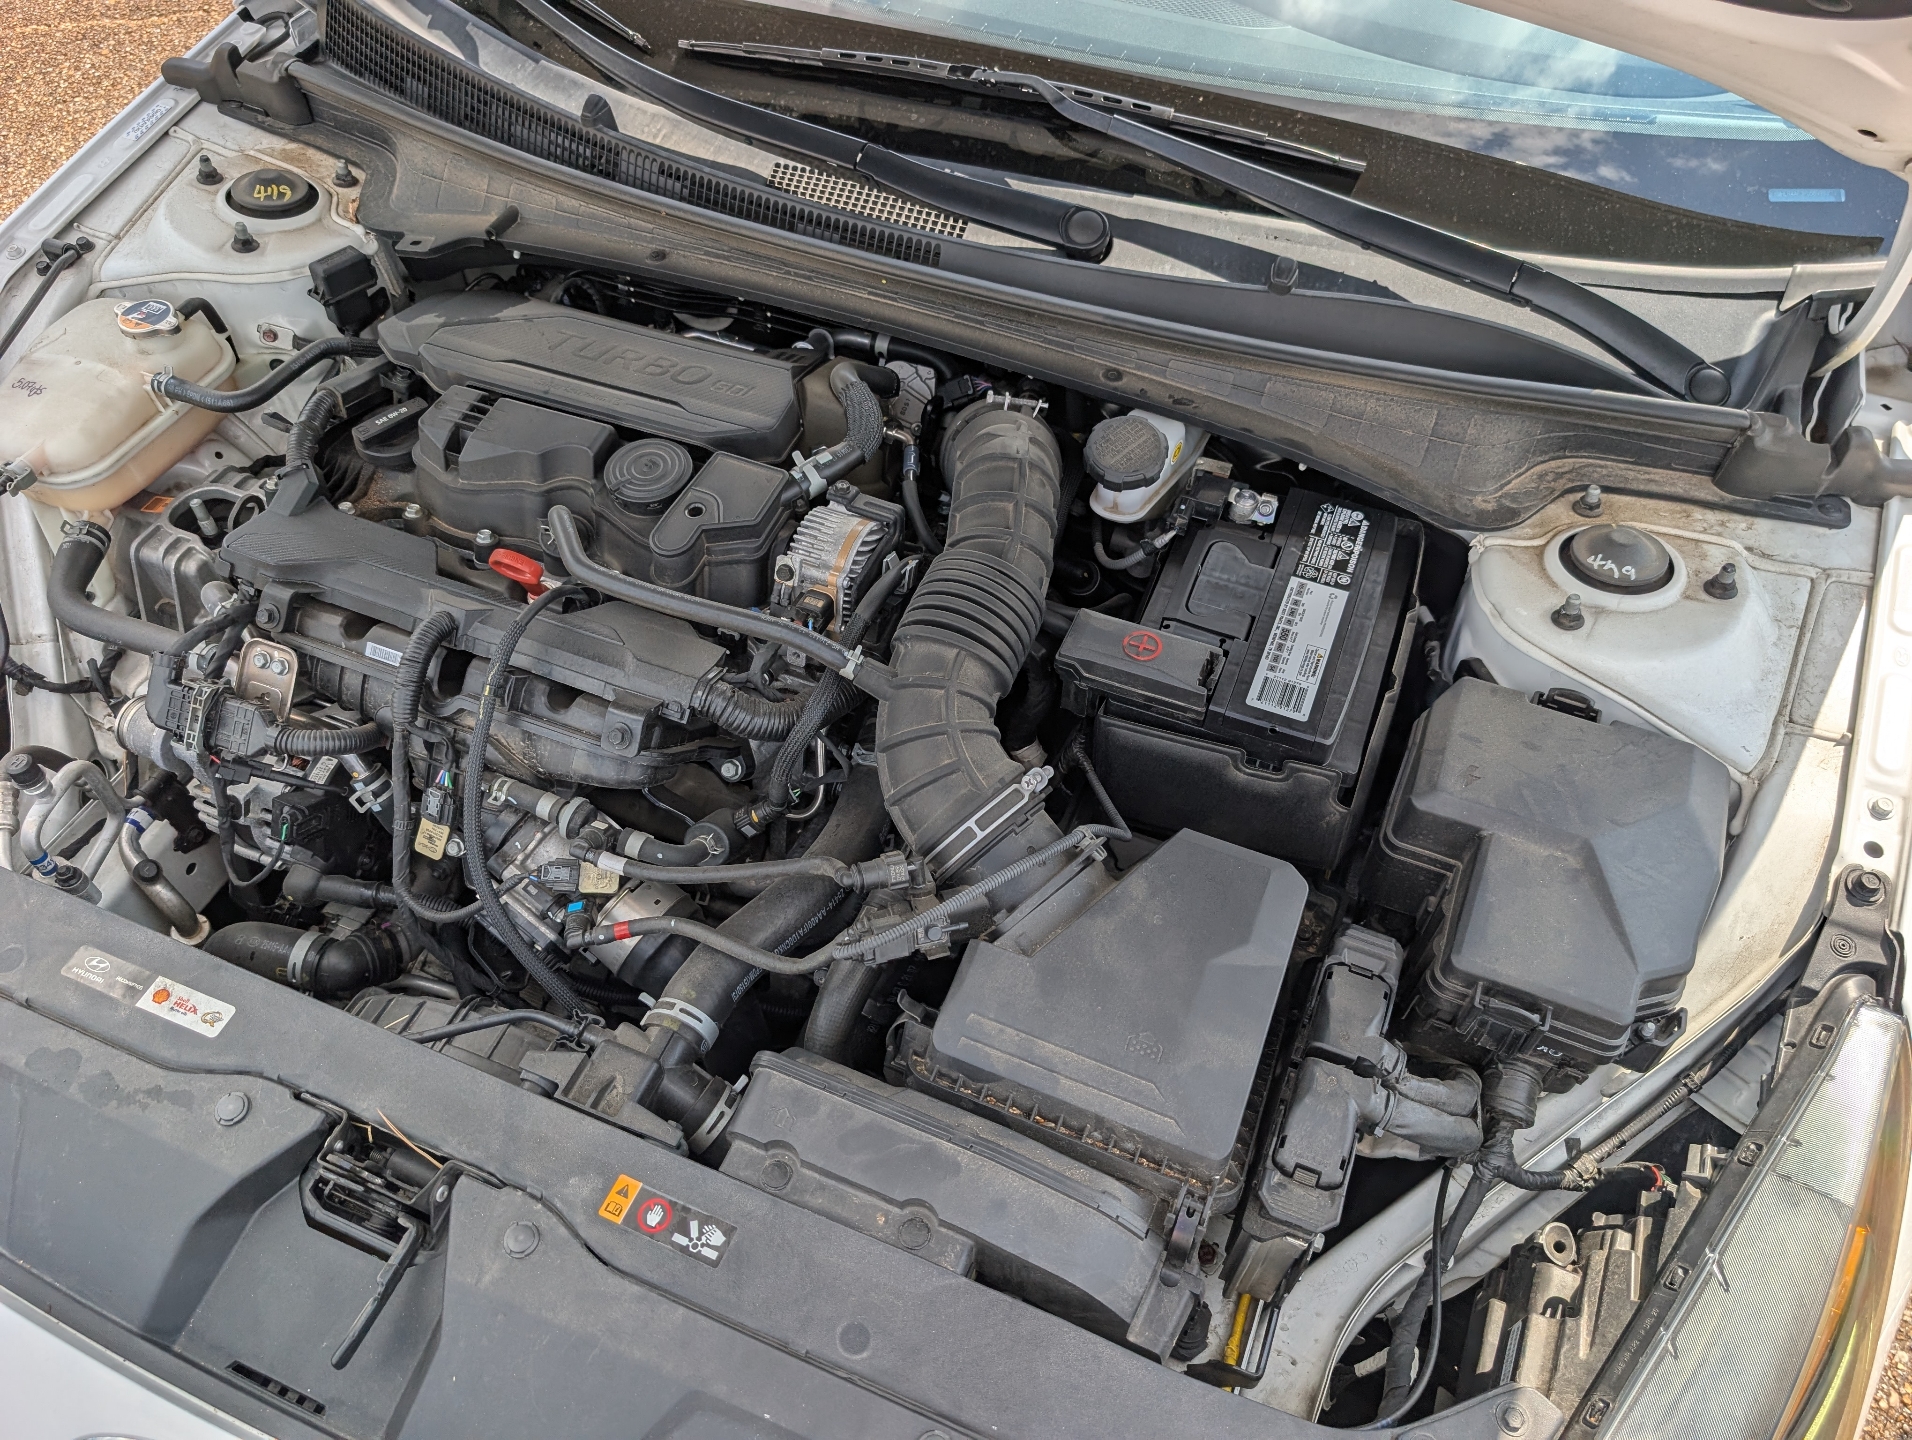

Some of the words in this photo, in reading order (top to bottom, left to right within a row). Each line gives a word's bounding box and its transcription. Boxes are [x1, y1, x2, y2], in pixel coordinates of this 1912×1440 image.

[548, 330, 713, 386] TURBO
[375, 417, 388, 426] SAE
[1278, 628, 1290, 641] 550
[72, 966, 104, 984] HYUNDAI
[178, 996, 190, 1004] Shell
[173, 1000, 198, 1016] HELIX
